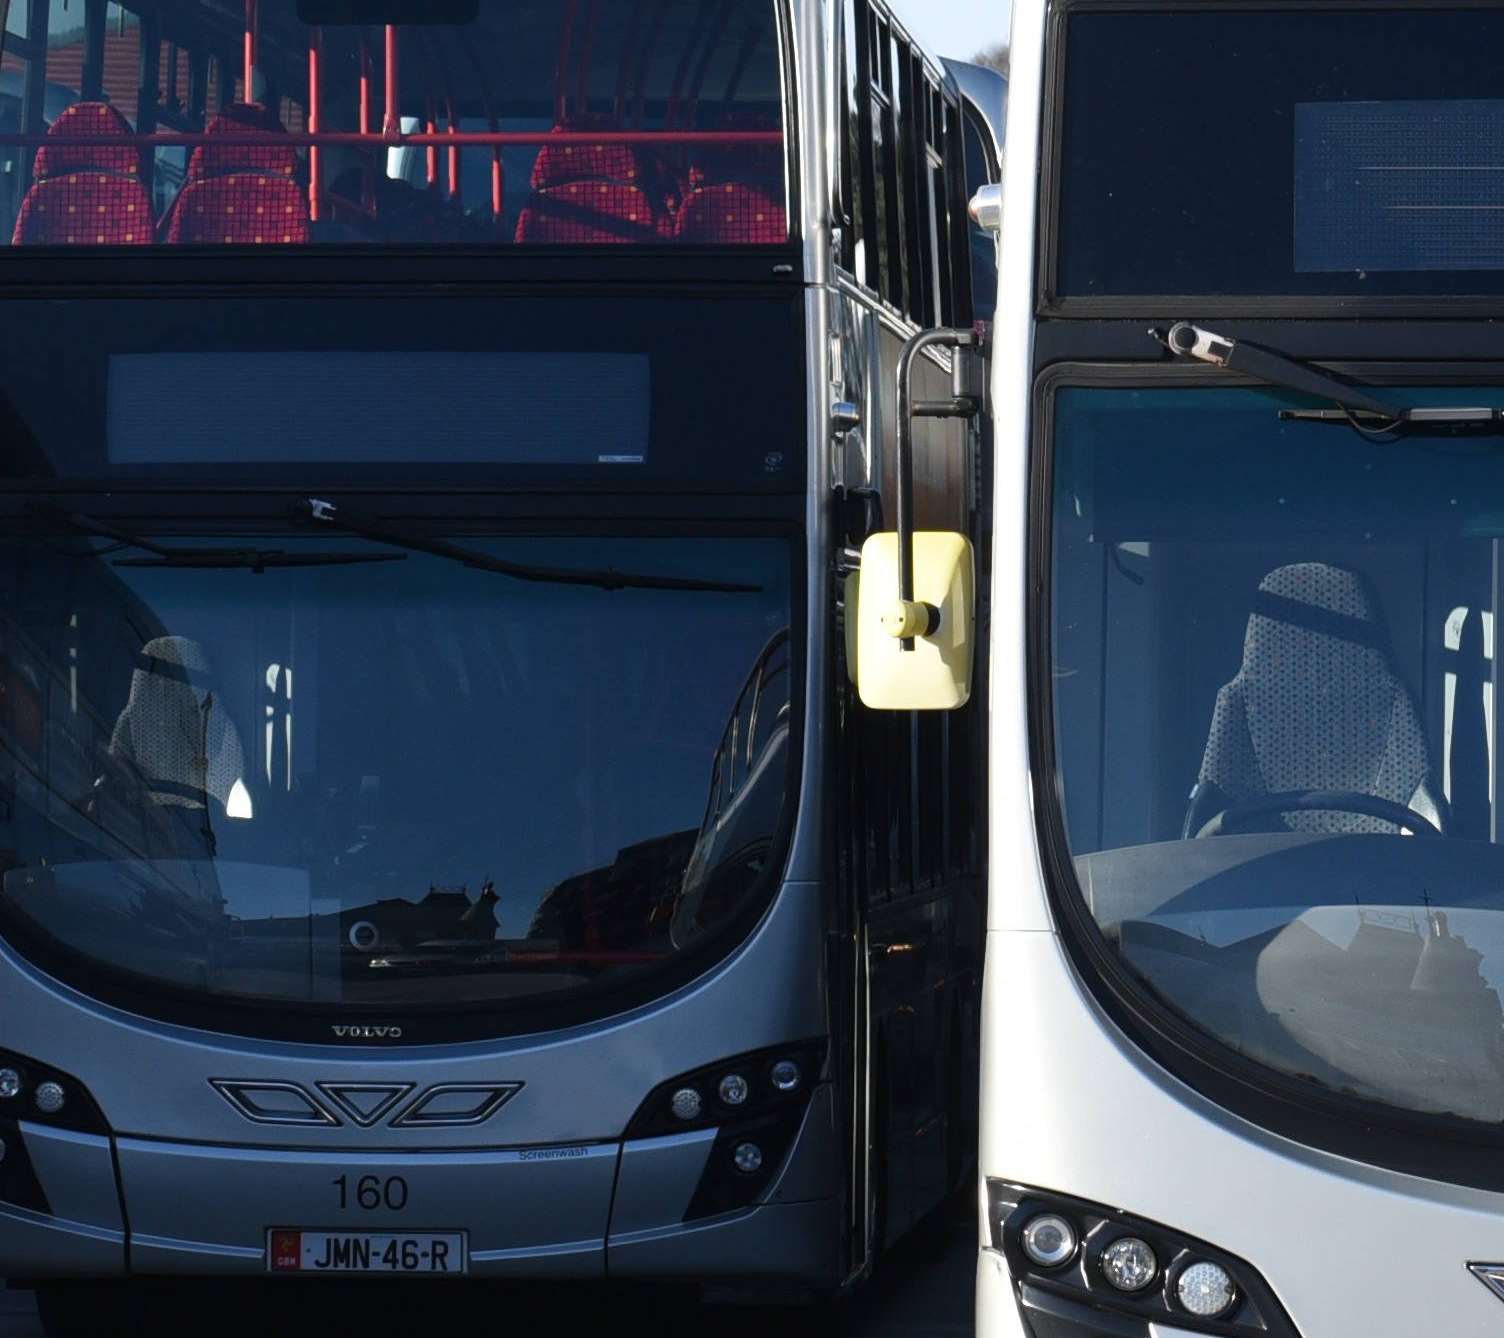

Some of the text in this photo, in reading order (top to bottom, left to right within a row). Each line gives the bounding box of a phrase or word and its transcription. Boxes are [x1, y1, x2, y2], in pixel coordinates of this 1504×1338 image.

[331, 1025, 402, 1038] VOLVO
[518, 1146, 589, 1161] Screenwash
[332, 1173, 409, 1211] 160
[314, 1237, 449, 1271] JMN-46-R
